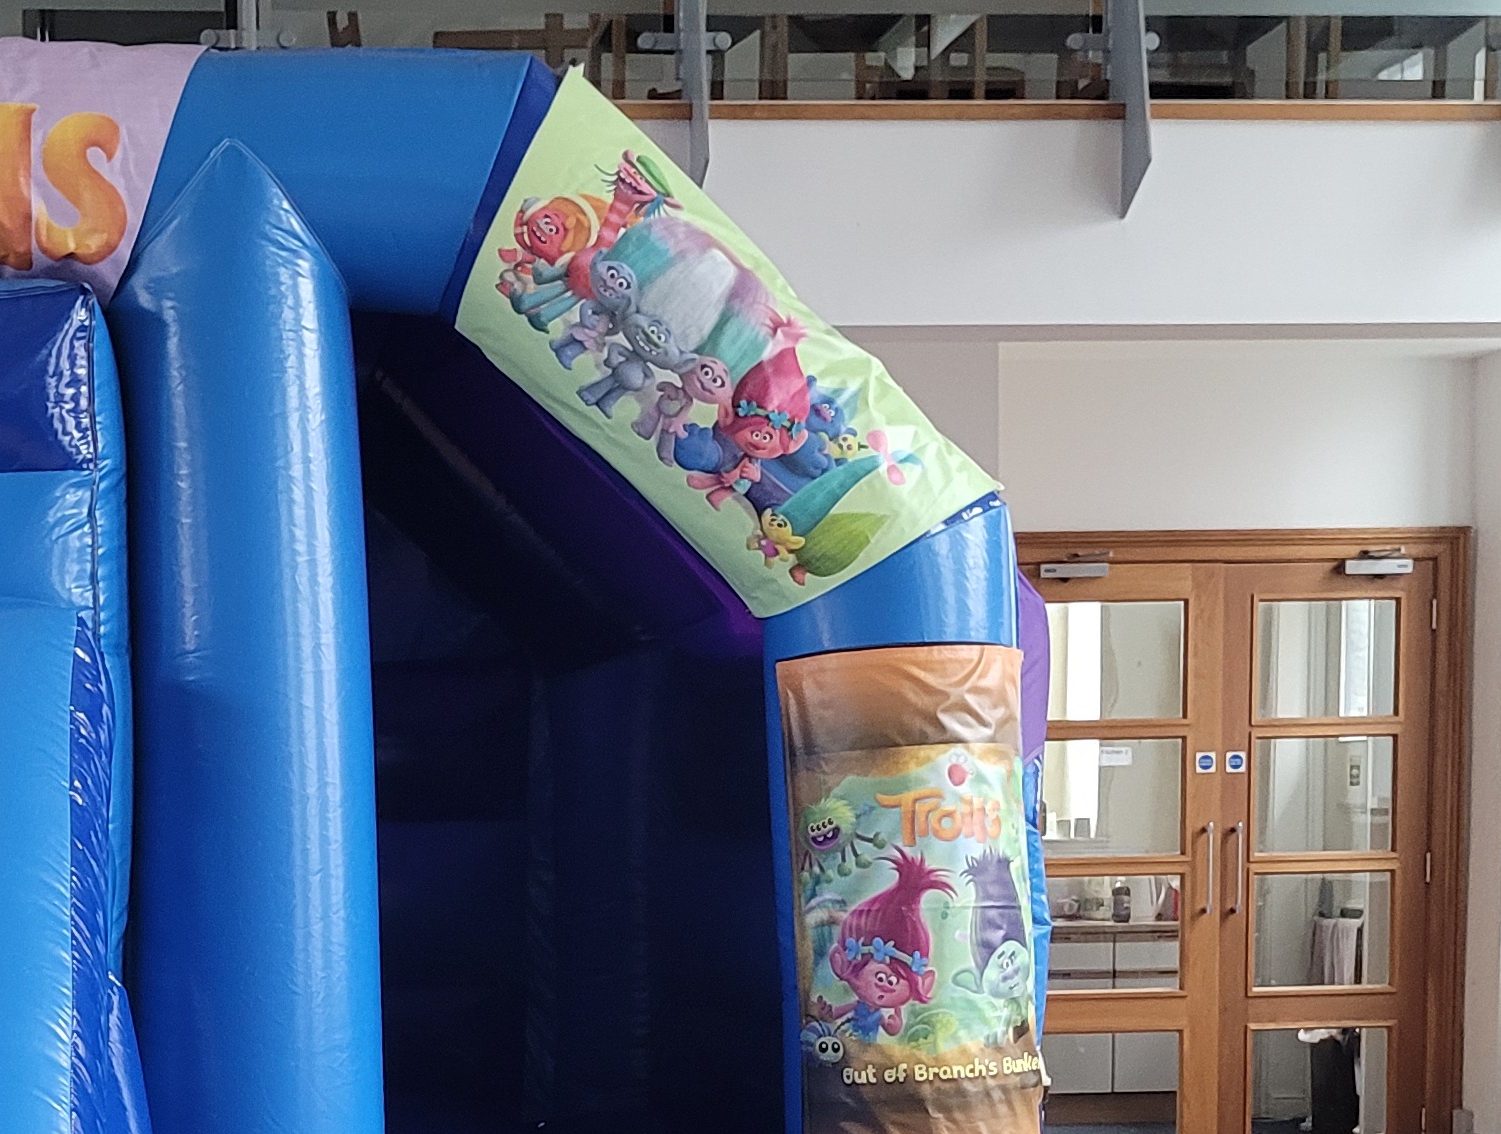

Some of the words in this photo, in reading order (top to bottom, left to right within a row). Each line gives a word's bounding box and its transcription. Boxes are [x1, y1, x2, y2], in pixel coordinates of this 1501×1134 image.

[874, 787, 1001, 847] Trolls
[842, 1064, 877, 1085] Out
[884, 1063, 907, 1083] of
[914, 1058, 998, 1082] Branch's
[1002, 1051, 1040, 1075] Bunke
